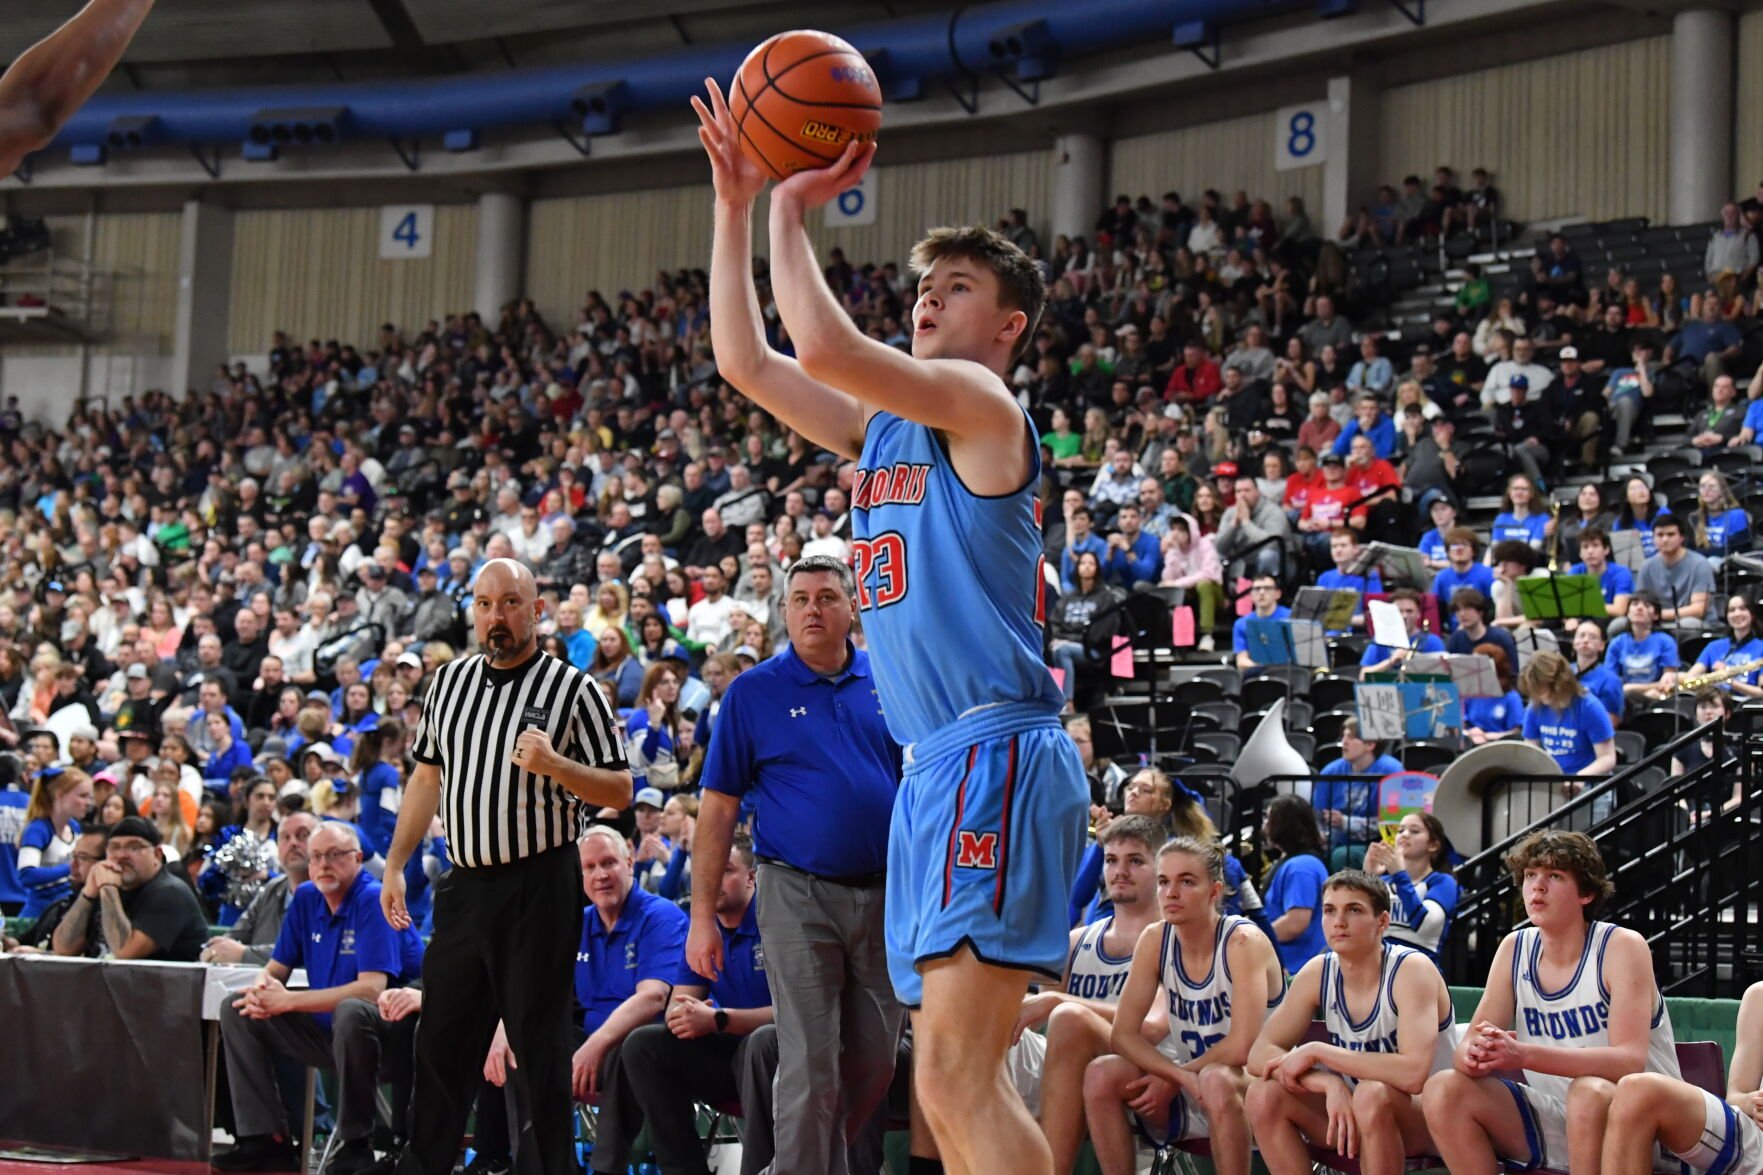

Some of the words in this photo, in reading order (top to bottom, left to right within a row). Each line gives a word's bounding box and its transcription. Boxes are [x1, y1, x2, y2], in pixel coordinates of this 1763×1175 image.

[804, 121, 840, 142] PRO
[1287, 111, 1315, 157] 8
[838, 180, 865, 217] 6
[392, 211, 421, 249] 4
[853, 531, 908, 612] 23
[955, 829, 999, 869] M
